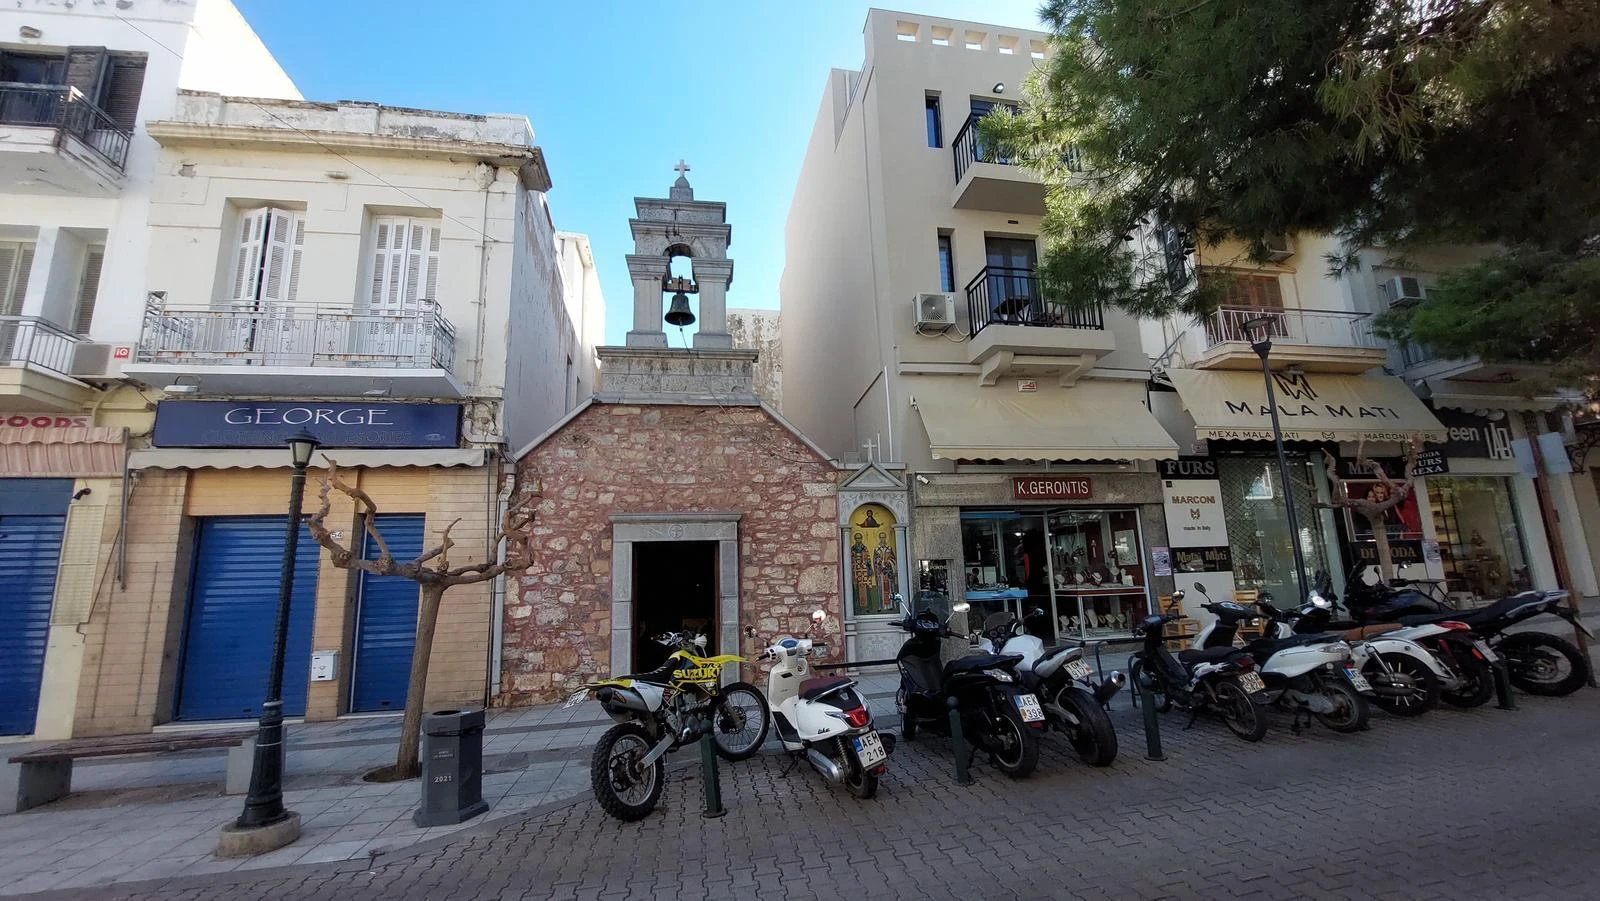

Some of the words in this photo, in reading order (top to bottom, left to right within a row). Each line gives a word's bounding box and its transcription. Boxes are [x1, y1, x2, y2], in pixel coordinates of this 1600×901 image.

[1224, 400, 1319, 416] MALA
[1325, 404, 1400, 419] MATI
[224, 407, 394, 425] GEORGE
[1208, 430, 1240, 439] MEXA
[1242, 431, 1272, 439] MALA
[1449, 427, 1480, 441] een
[1484, 422, 1513, 460] LAB
[1165, 460, 1216, 475] FURS
[1417, 457, 1443, 467] URS
[1017, 481, 1089, 494] K.GERONTIS
[1171, 496, 1216, 504] MARCONI
[1360, 548, 1376, 559] DI
[1390, 547, 1417, 558] ODA
[672, 668, 721, 679] SUZUKI
[1026, 708, 1043, 718] 398
[866, 746, 885, 762] 218
[433, 775, 453, 783] 2021
